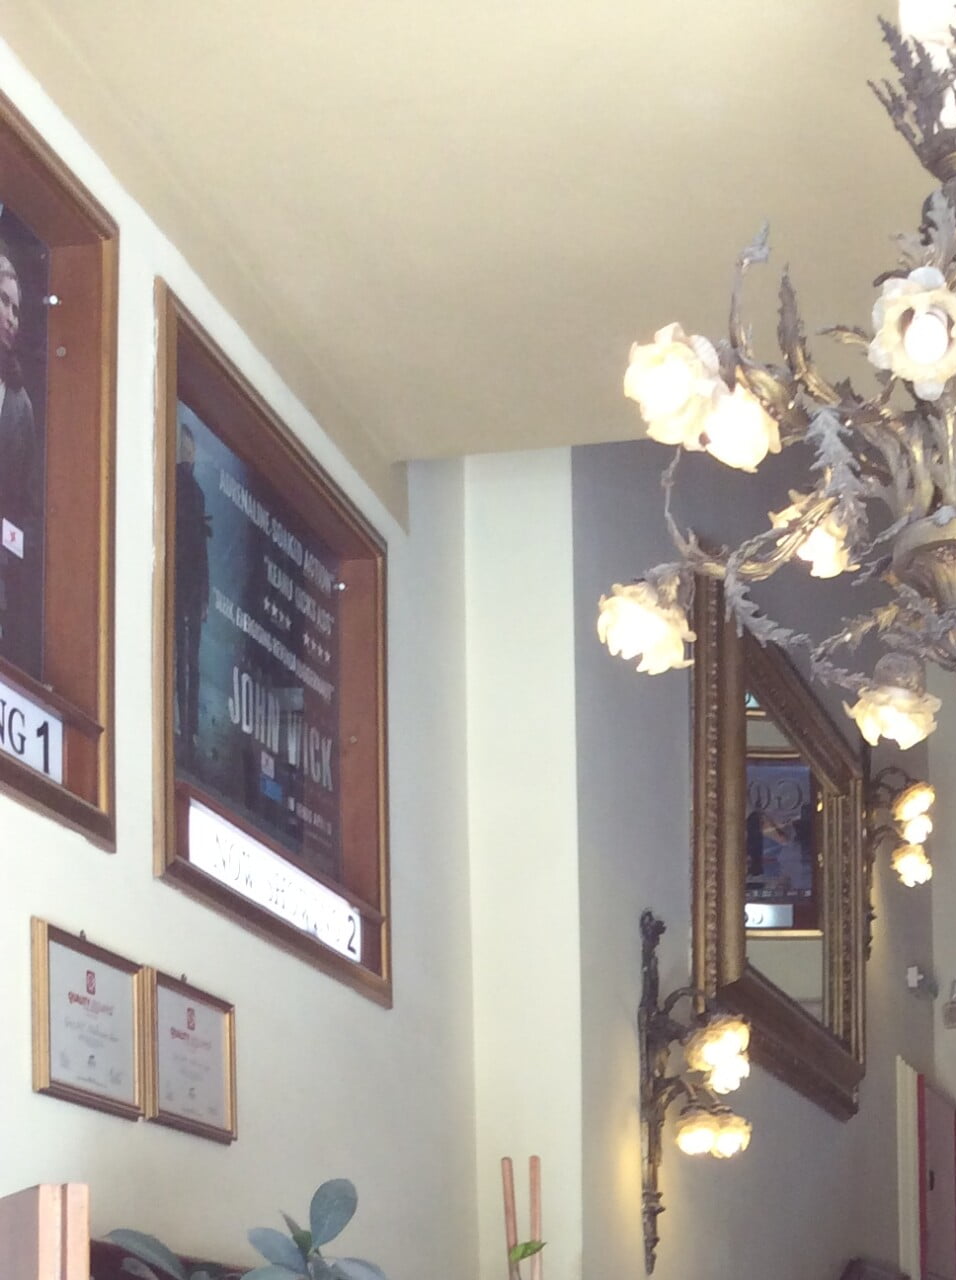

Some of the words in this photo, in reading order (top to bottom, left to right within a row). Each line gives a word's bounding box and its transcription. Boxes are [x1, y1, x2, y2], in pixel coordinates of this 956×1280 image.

[36, 720, 50, 775] 1
[228, 665, 280, 755] JOHN
[287, 711, 334, 792] WICK
